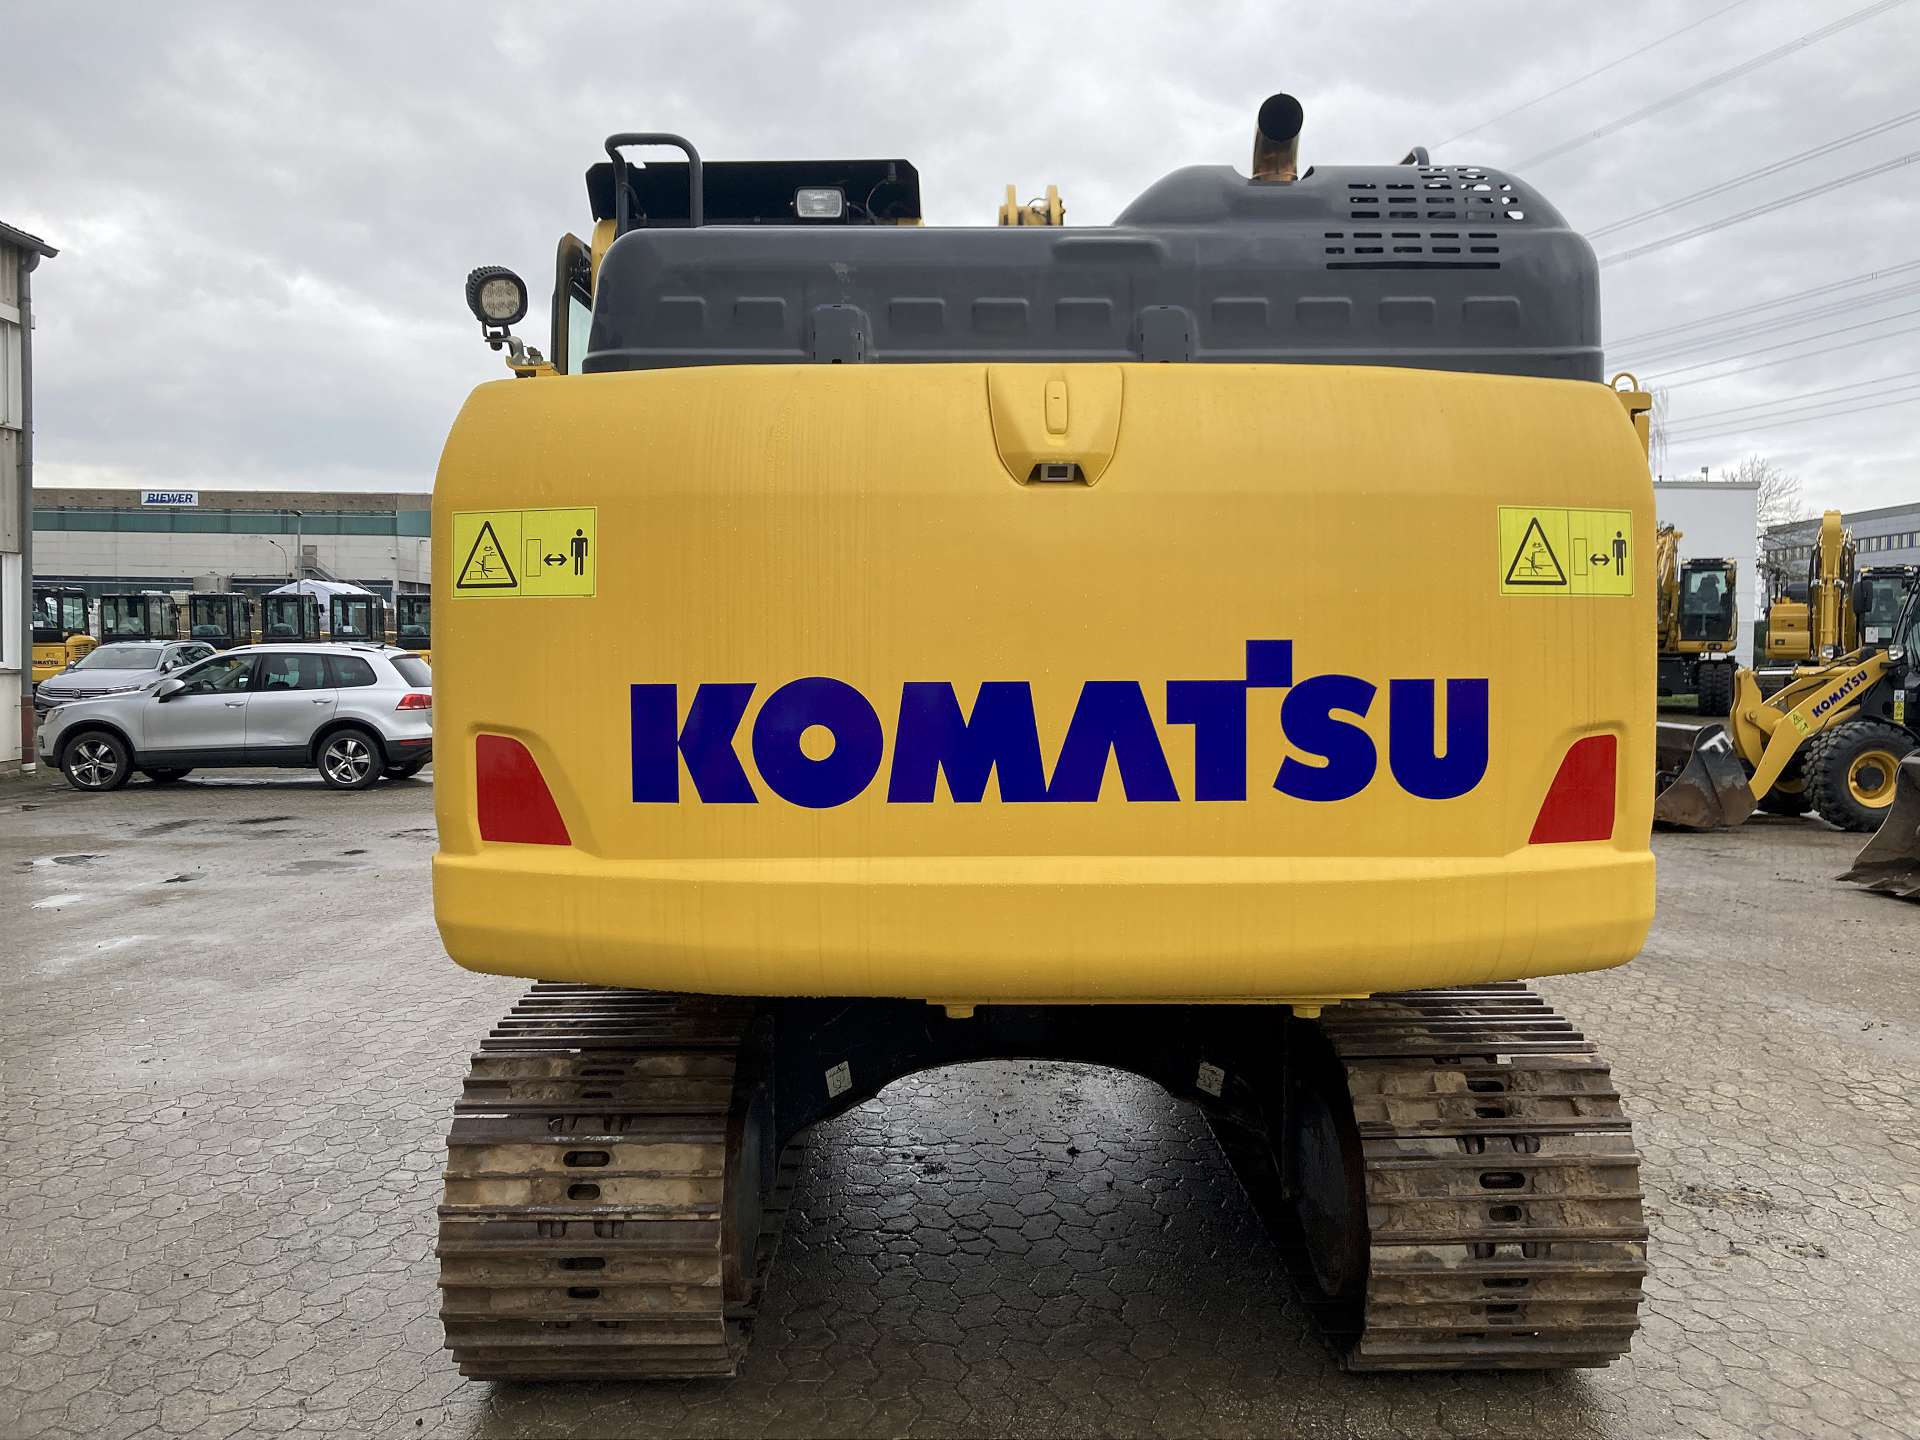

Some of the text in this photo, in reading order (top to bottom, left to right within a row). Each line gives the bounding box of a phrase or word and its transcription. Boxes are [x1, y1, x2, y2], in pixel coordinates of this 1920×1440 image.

[145, 493, 193, 504] BIEWER
[1812, 670, 1868, 718] KOMATSU
[630, 640, 1489, 809] KOMATSU
